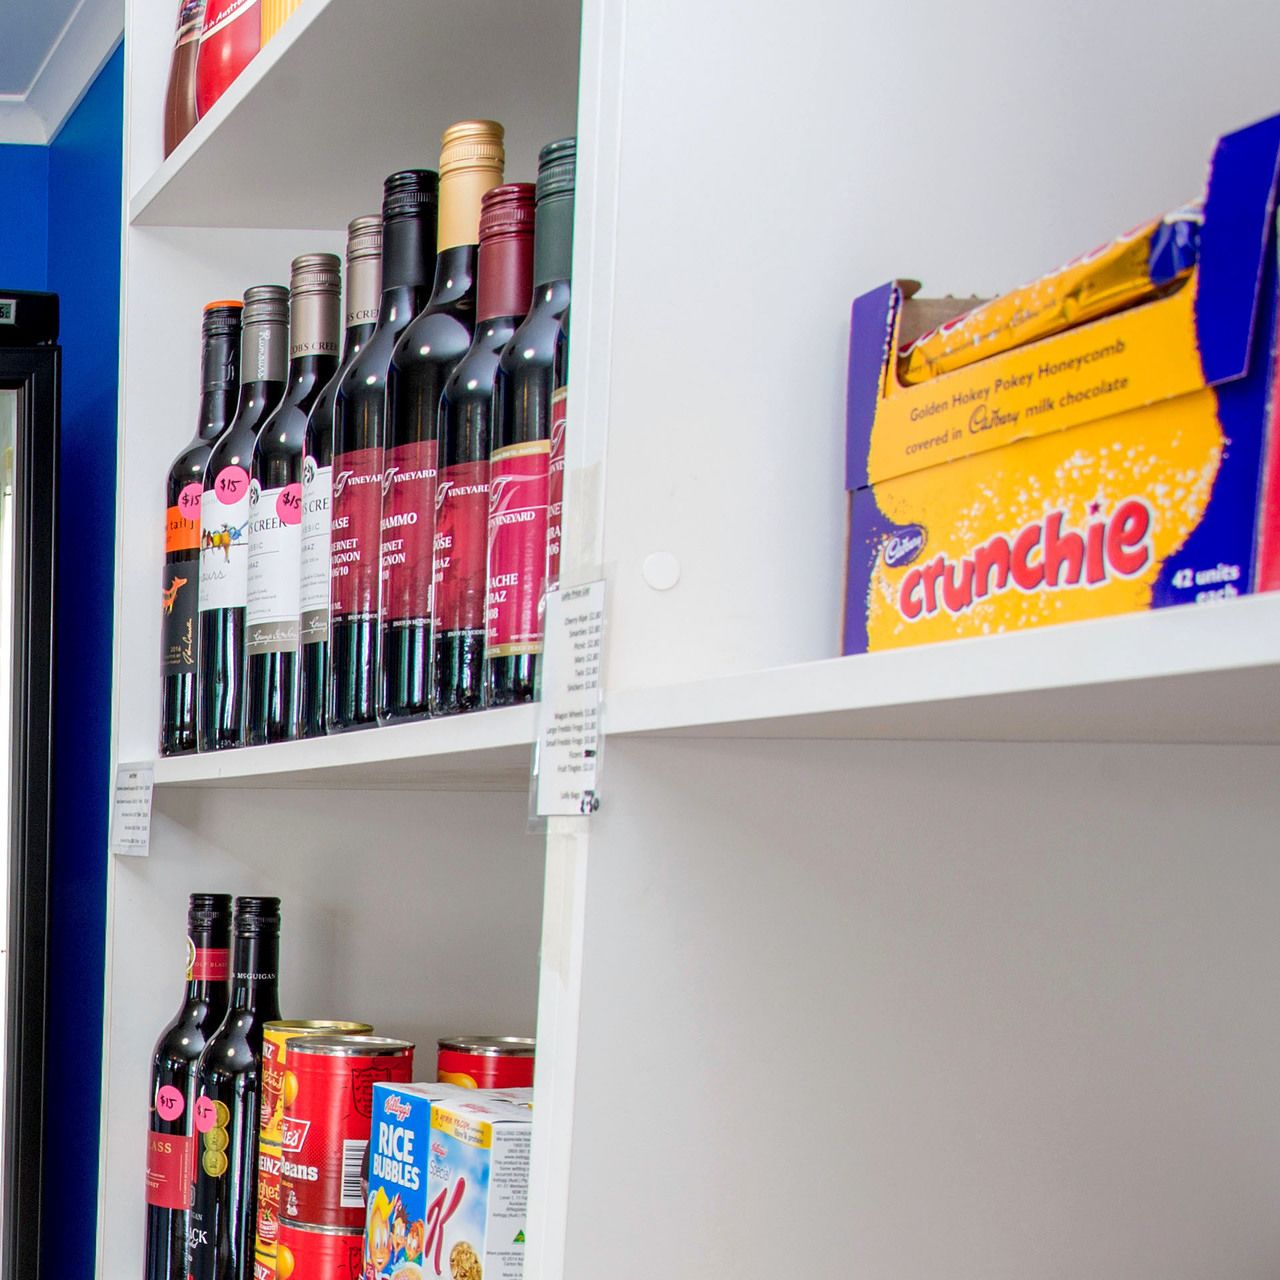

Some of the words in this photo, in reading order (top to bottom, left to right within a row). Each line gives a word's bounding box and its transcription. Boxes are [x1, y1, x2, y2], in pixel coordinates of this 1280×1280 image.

[910, 400, 949, 422] Golden
[952, 387, 990, 410] Hokey
[994, 374, 1032, 396] Pokey
[1038, 339, 1126, 379] Honeycomb
[905, 433, 949, 456] covered
[952, 428, 963, 441] in
[968, 403, 1020, 437] Cadbury
[1025, 397, 1055, 418] milk
[1058, 375, 1130, 408] chocolate
[220, 480, 242, 493] $15
[393, 469, 437, 483] VINEYARD
[900, 500, 1152, 618] crunchie
[1172, 568, 1192, 588] 42
[1195, 564, 1240, 584] units
[159, 1096, 178, 1109] $15
[385, 1095, 411, 1120] Kellogg's
[379, 1122, 416, 1164] RICE
[373, 1153, 420, 1190] BUBBLES
[429, 1159, 451, 1182] Special
[424, 1177, 466, 1276] K
